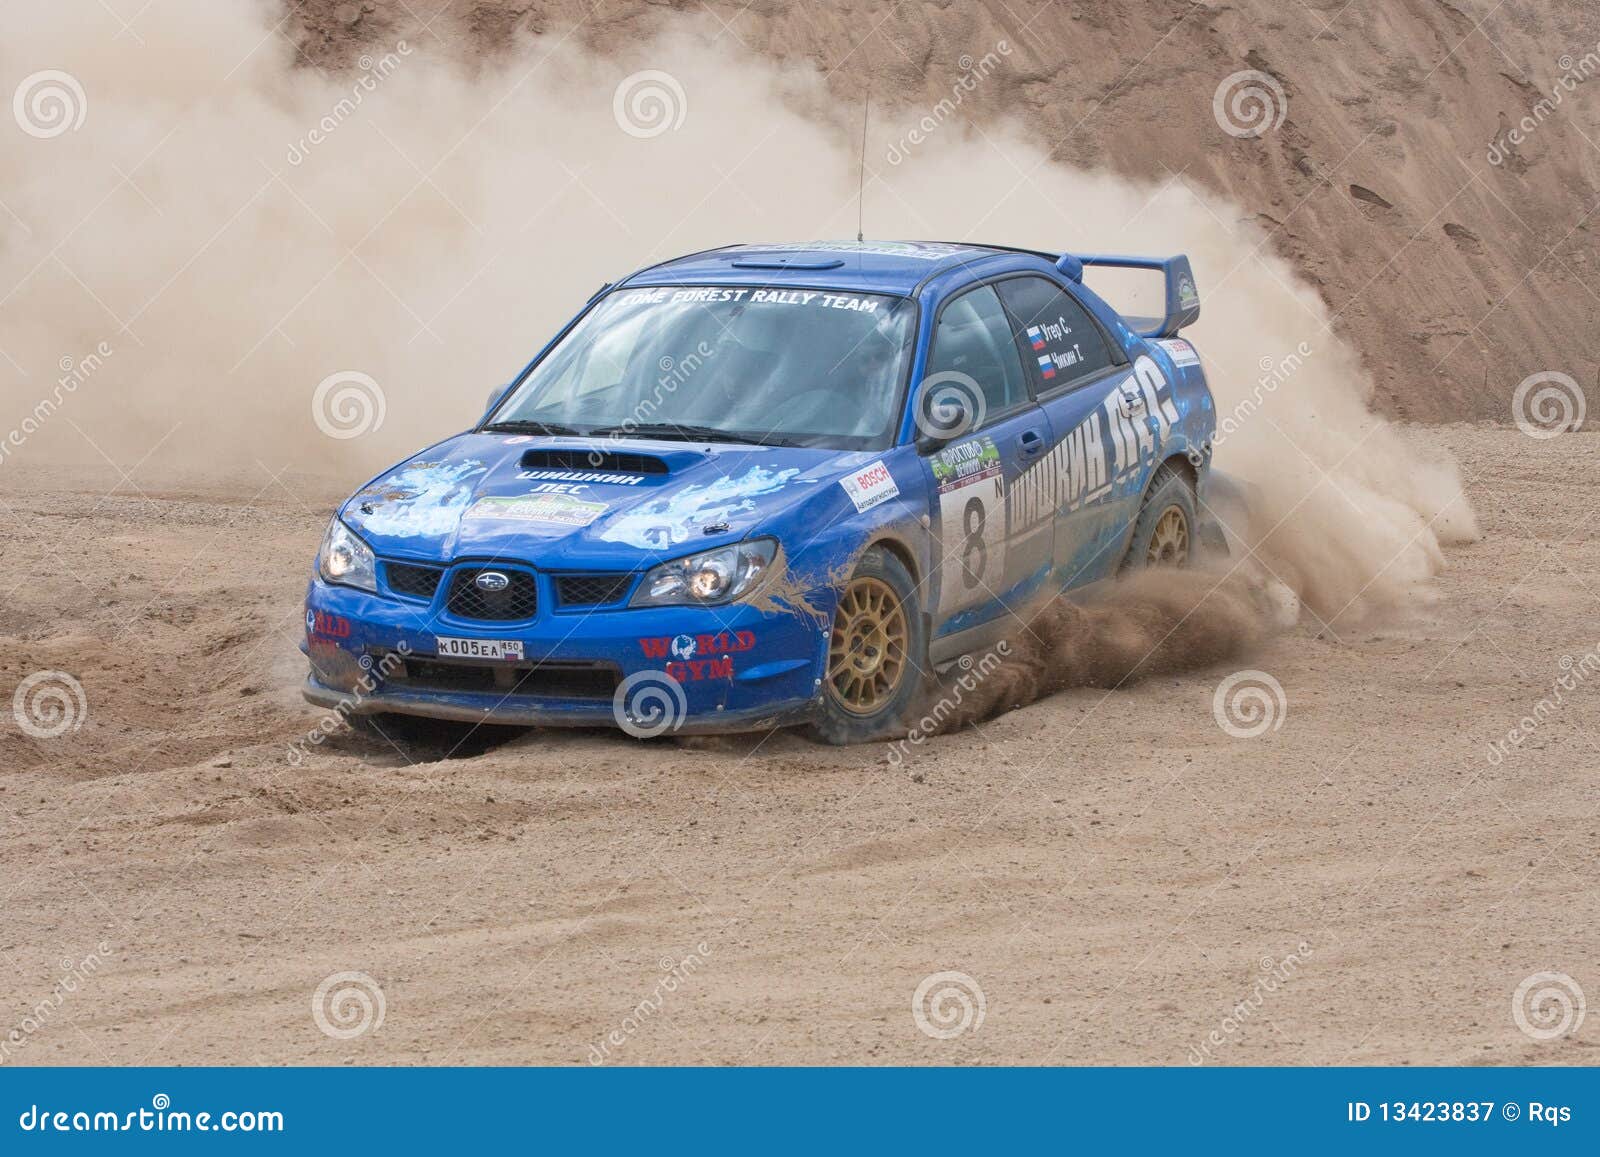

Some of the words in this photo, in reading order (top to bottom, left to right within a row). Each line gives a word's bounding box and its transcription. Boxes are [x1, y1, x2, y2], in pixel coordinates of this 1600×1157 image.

[670, 289, 748, 303] FOREST
[749, 290, 812, 306] RALLY
[822, 294, 879, 313] TEAM
[1040, 323, 1063, 342] Угер
[1051, 351, 1077, 370] Чикин
[515, 470, 645, 486] ШИШКИН
[857, 465, 890, 490] BOSCH
[994, 477, 1003, 498] N
[529, 483, 589, 495] ЛЕС
[963, 496, 987, 589] 8
[639, 630, 756, 659] WORLD
[665, 657, 734, 683] GYM
